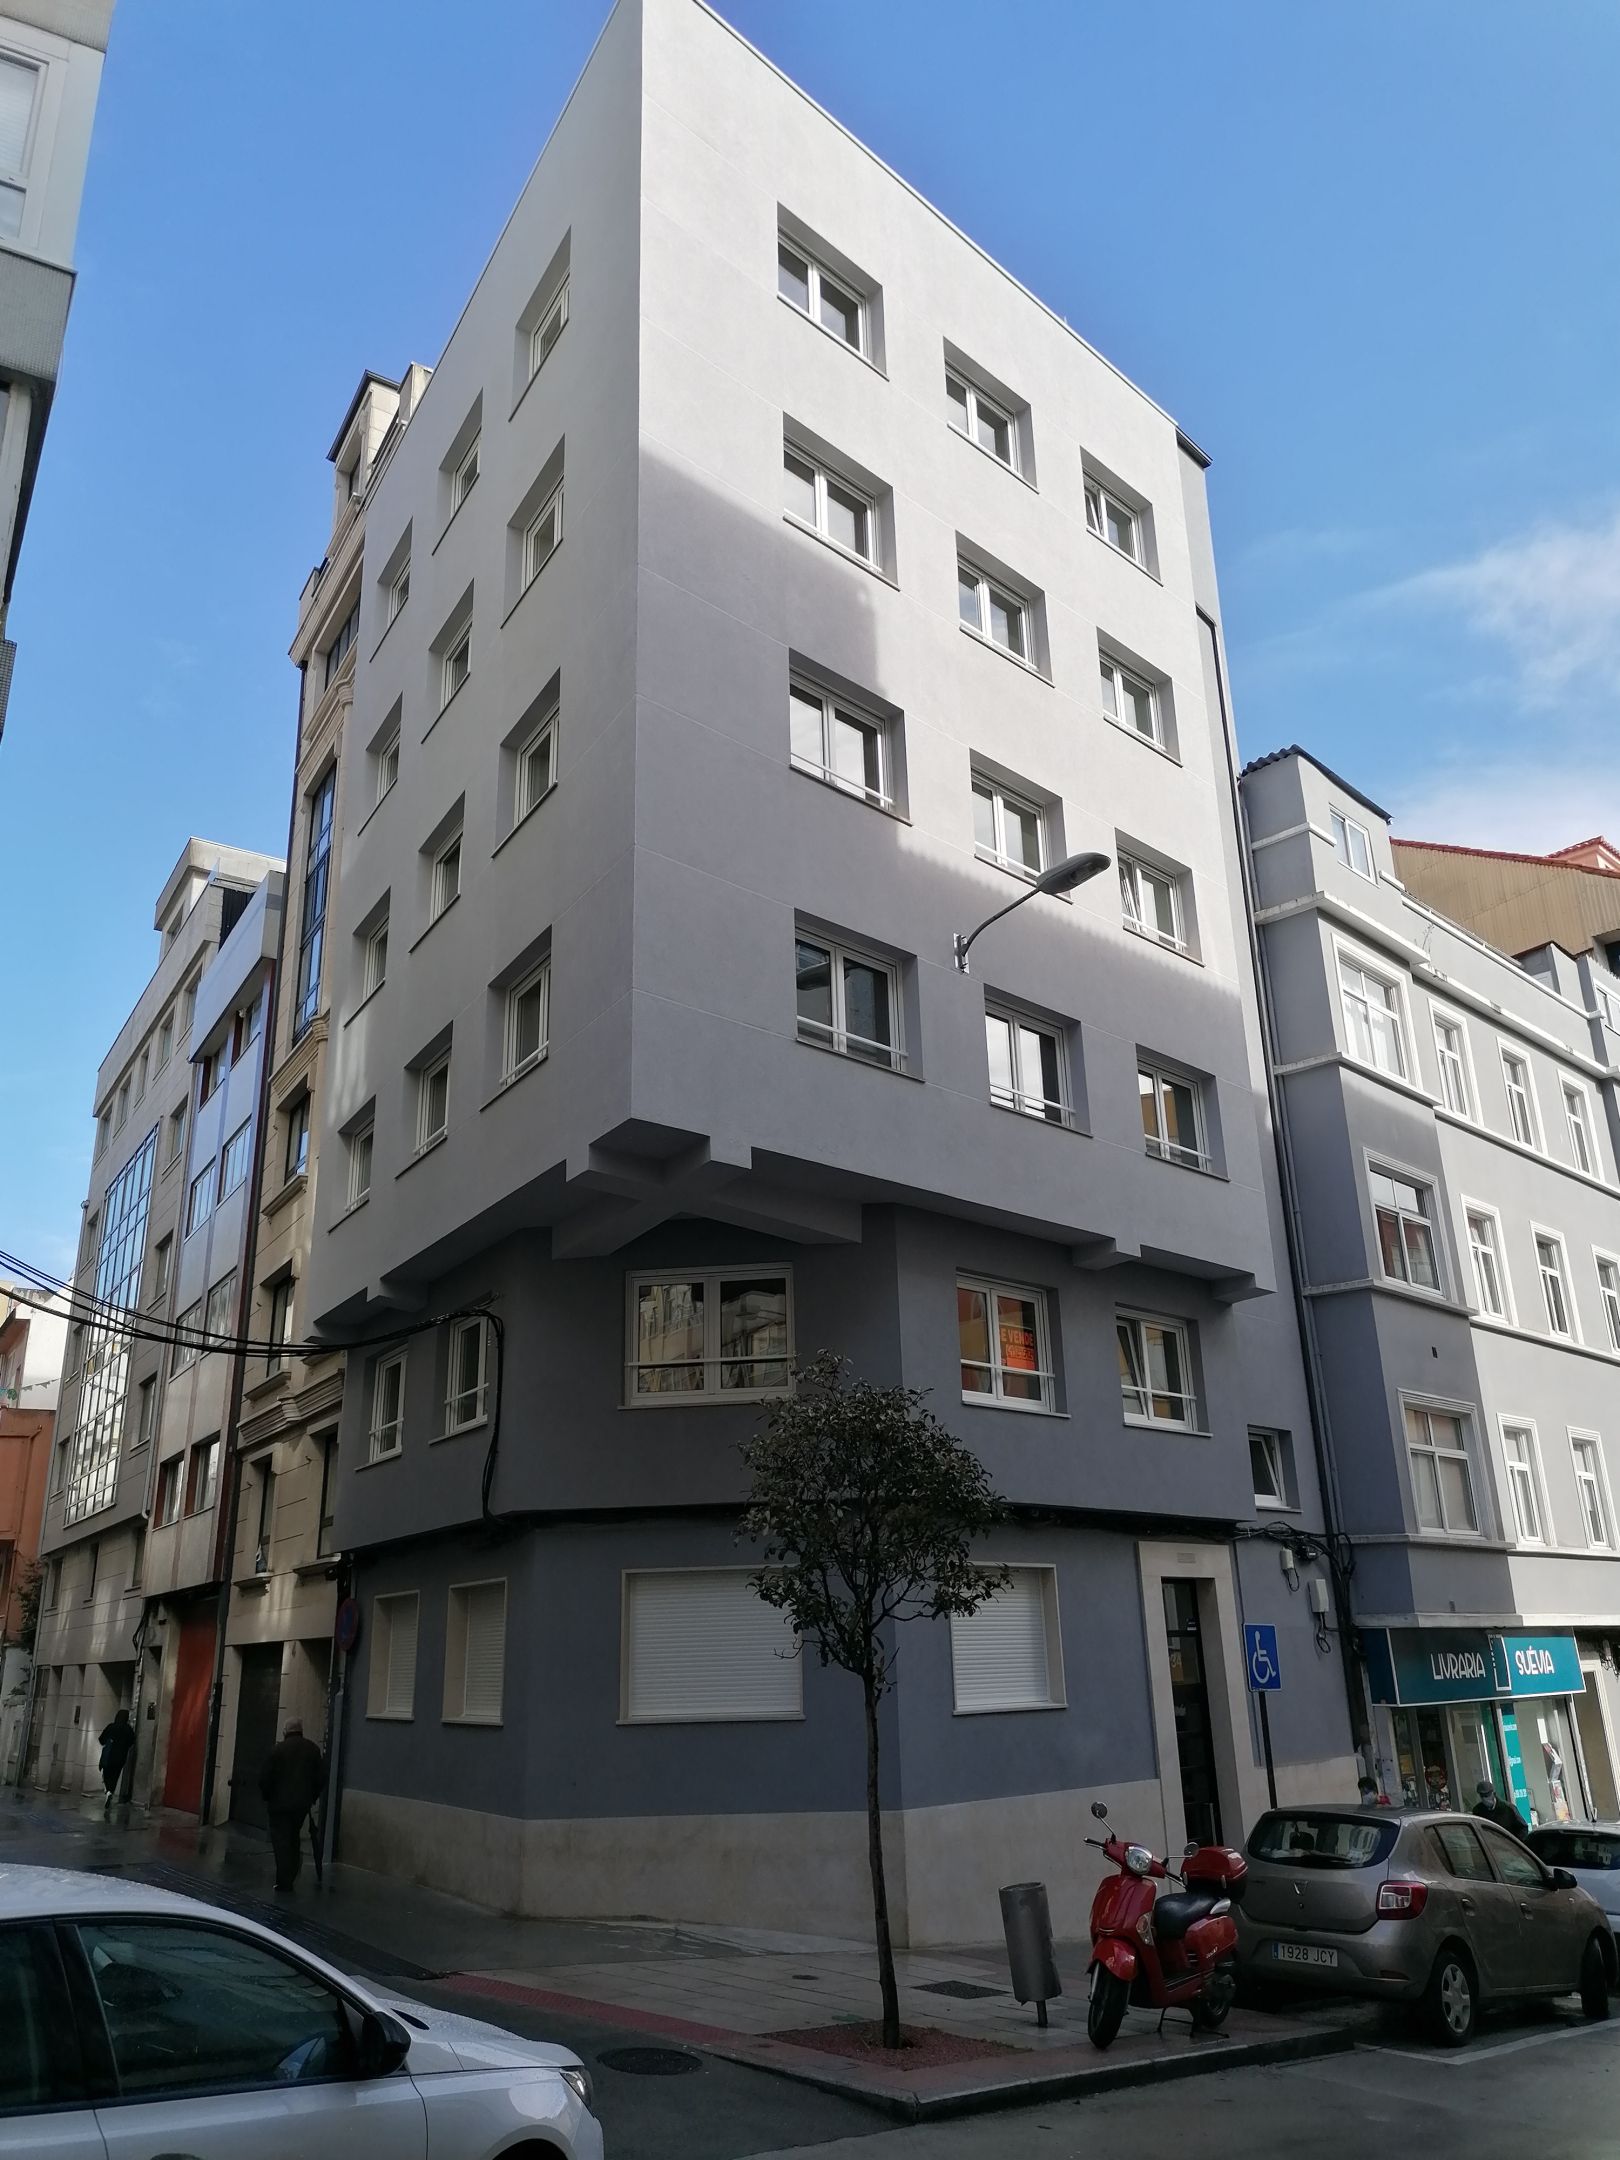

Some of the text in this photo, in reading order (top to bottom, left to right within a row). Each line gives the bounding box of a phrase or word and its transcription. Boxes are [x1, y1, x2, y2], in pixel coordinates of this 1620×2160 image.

[1430, 1645, 1555, 1680] LIVRARIA SUÉVIA
[1281, 1945, 1334, 1964] 1928 JCY
